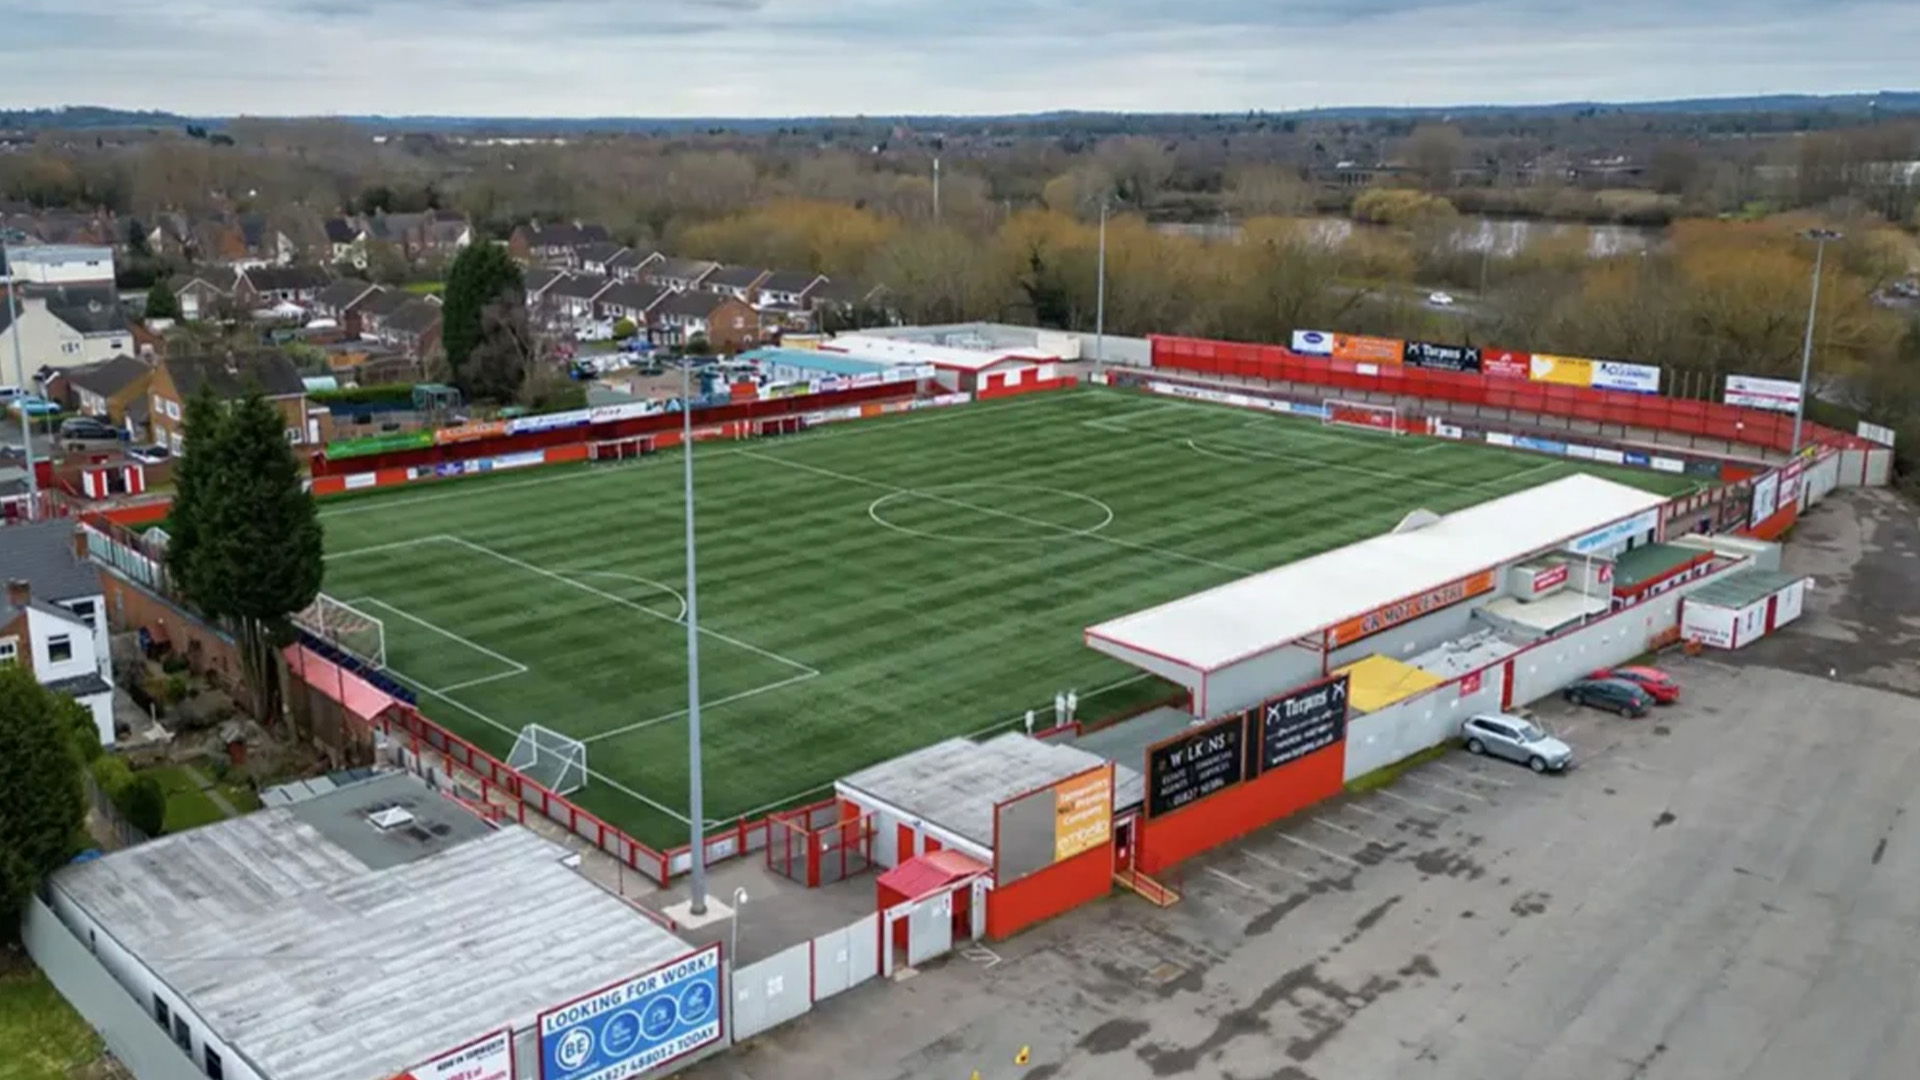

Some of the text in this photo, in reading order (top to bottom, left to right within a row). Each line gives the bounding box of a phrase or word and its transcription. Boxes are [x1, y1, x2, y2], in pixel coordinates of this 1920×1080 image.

[1285, 688, 1328, 717] Turpins
[546, 953, 714, 1032] LOOKING FOR WORK?
[564, 1037, 587, 1060] BE
[590, 1061, 627, 1080] 1827
[677, 1026, 715, 1051] TODAY
